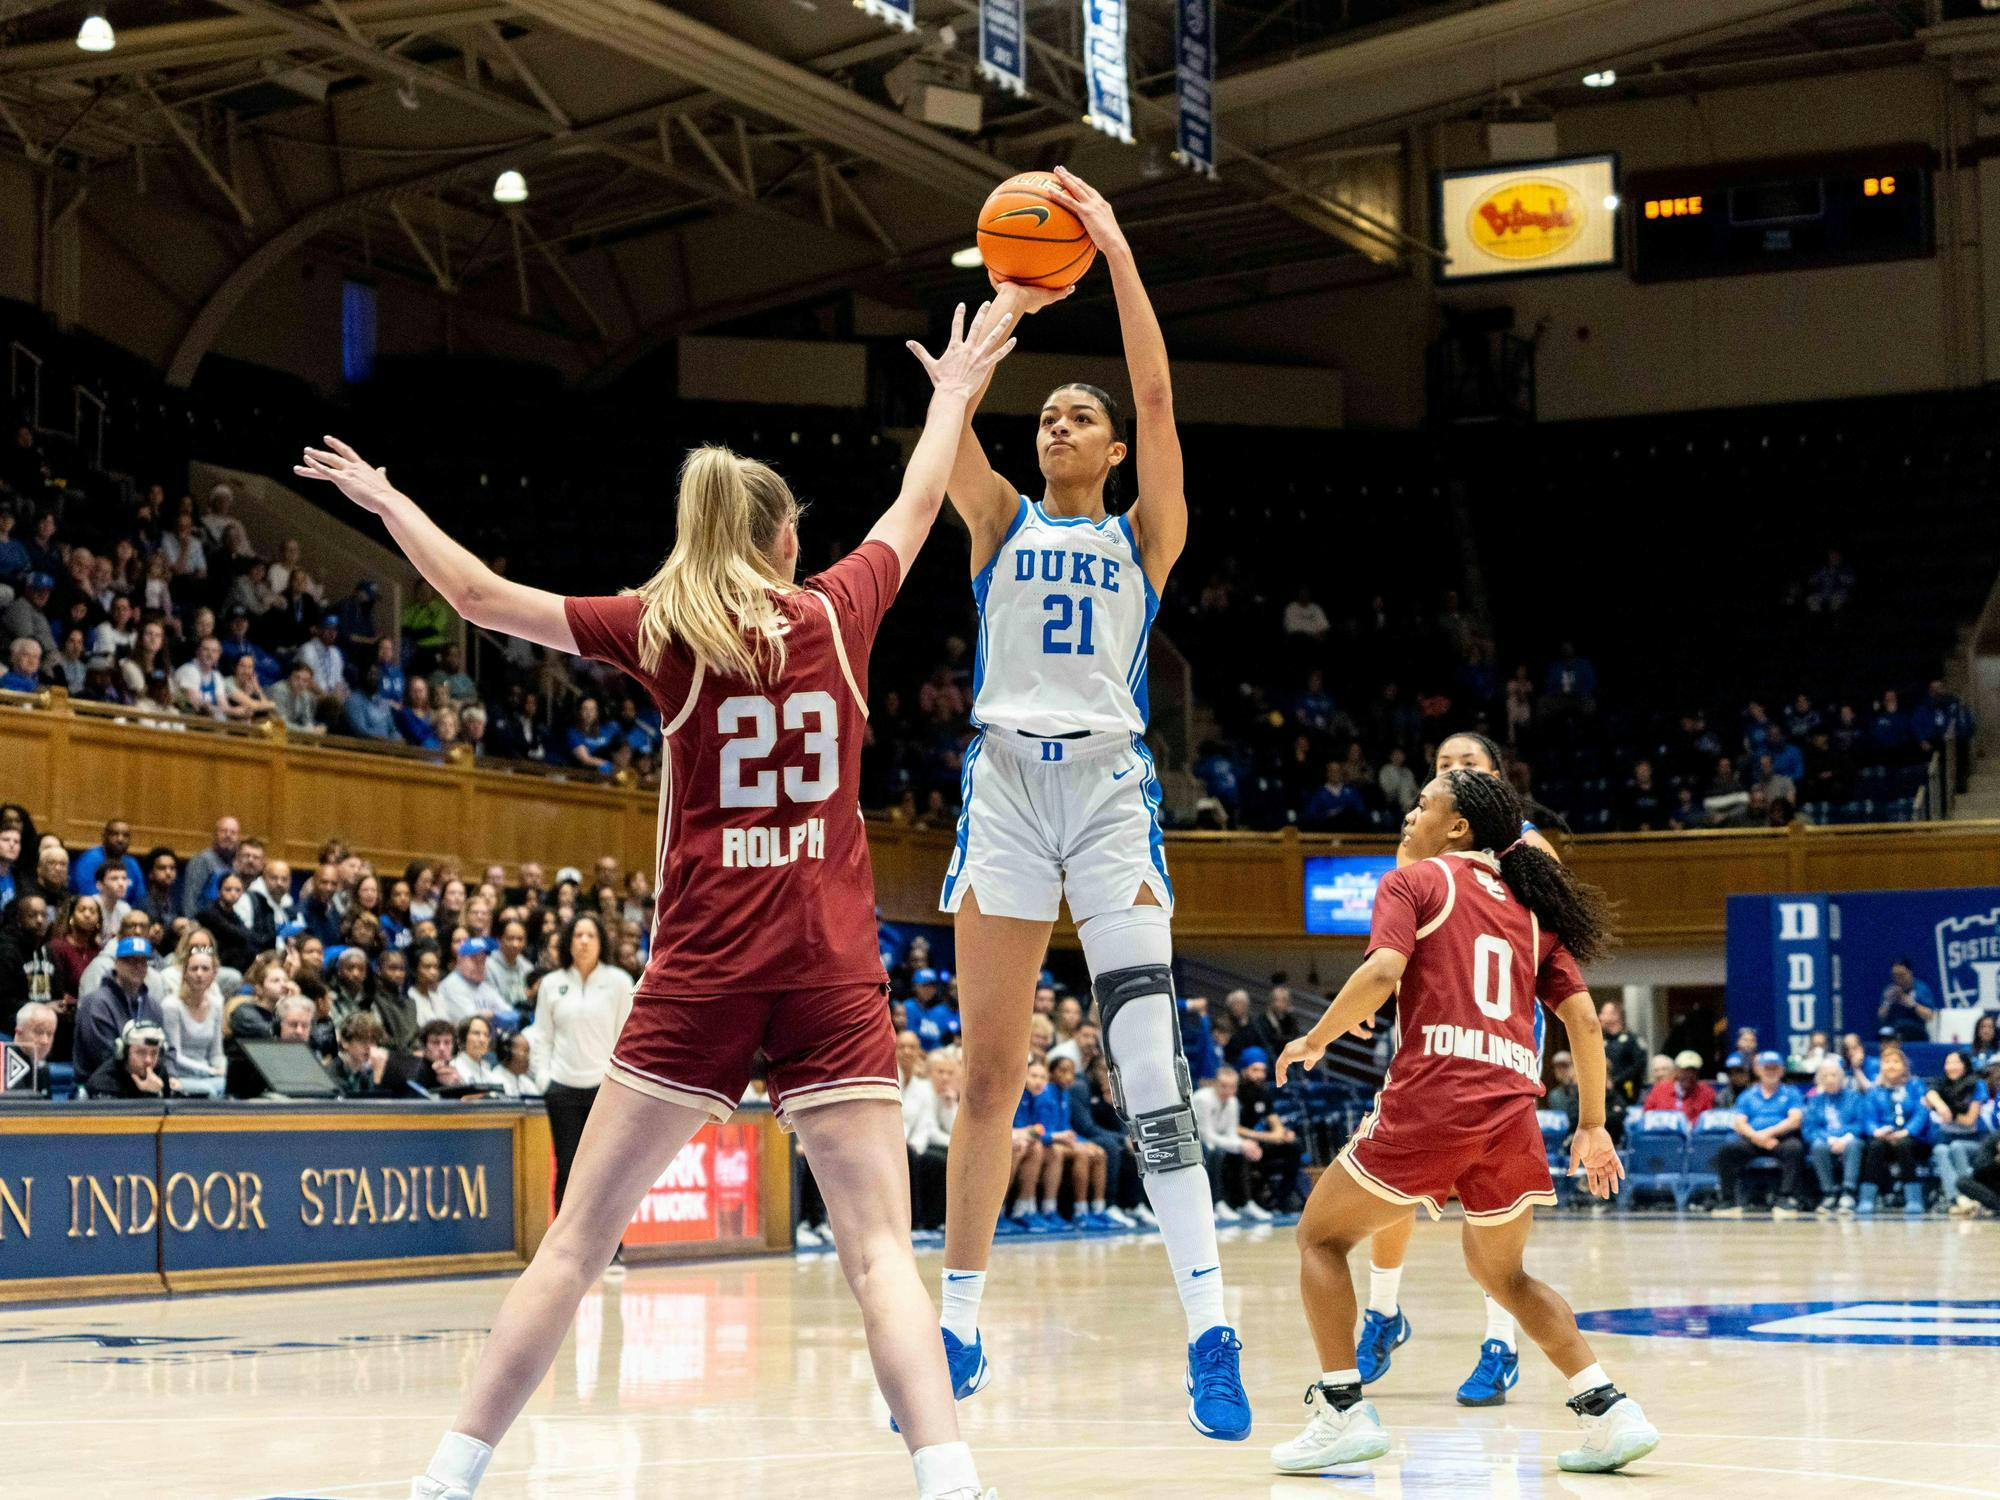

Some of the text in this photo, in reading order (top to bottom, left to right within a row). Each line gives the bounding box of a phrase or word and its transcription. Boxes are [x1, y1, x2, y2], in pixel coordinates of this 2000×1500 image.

[1645, 196, 1703, 220] DUKE
[1864, 176, 1895, 196] BC
[1015, 549, 1120, 594] DUKE
[1043, 594, 1095, 655] 21
[717, 691, 840, 809] 23
[1041, 741, 1064, 762] D
[722, 818, 826, 868] ROLPH
[1473, 933, 1514, 1022] 0
[67, 1171, 268, 1237] INDOOR
[300, 1165, 488, 1227] STADIUM
